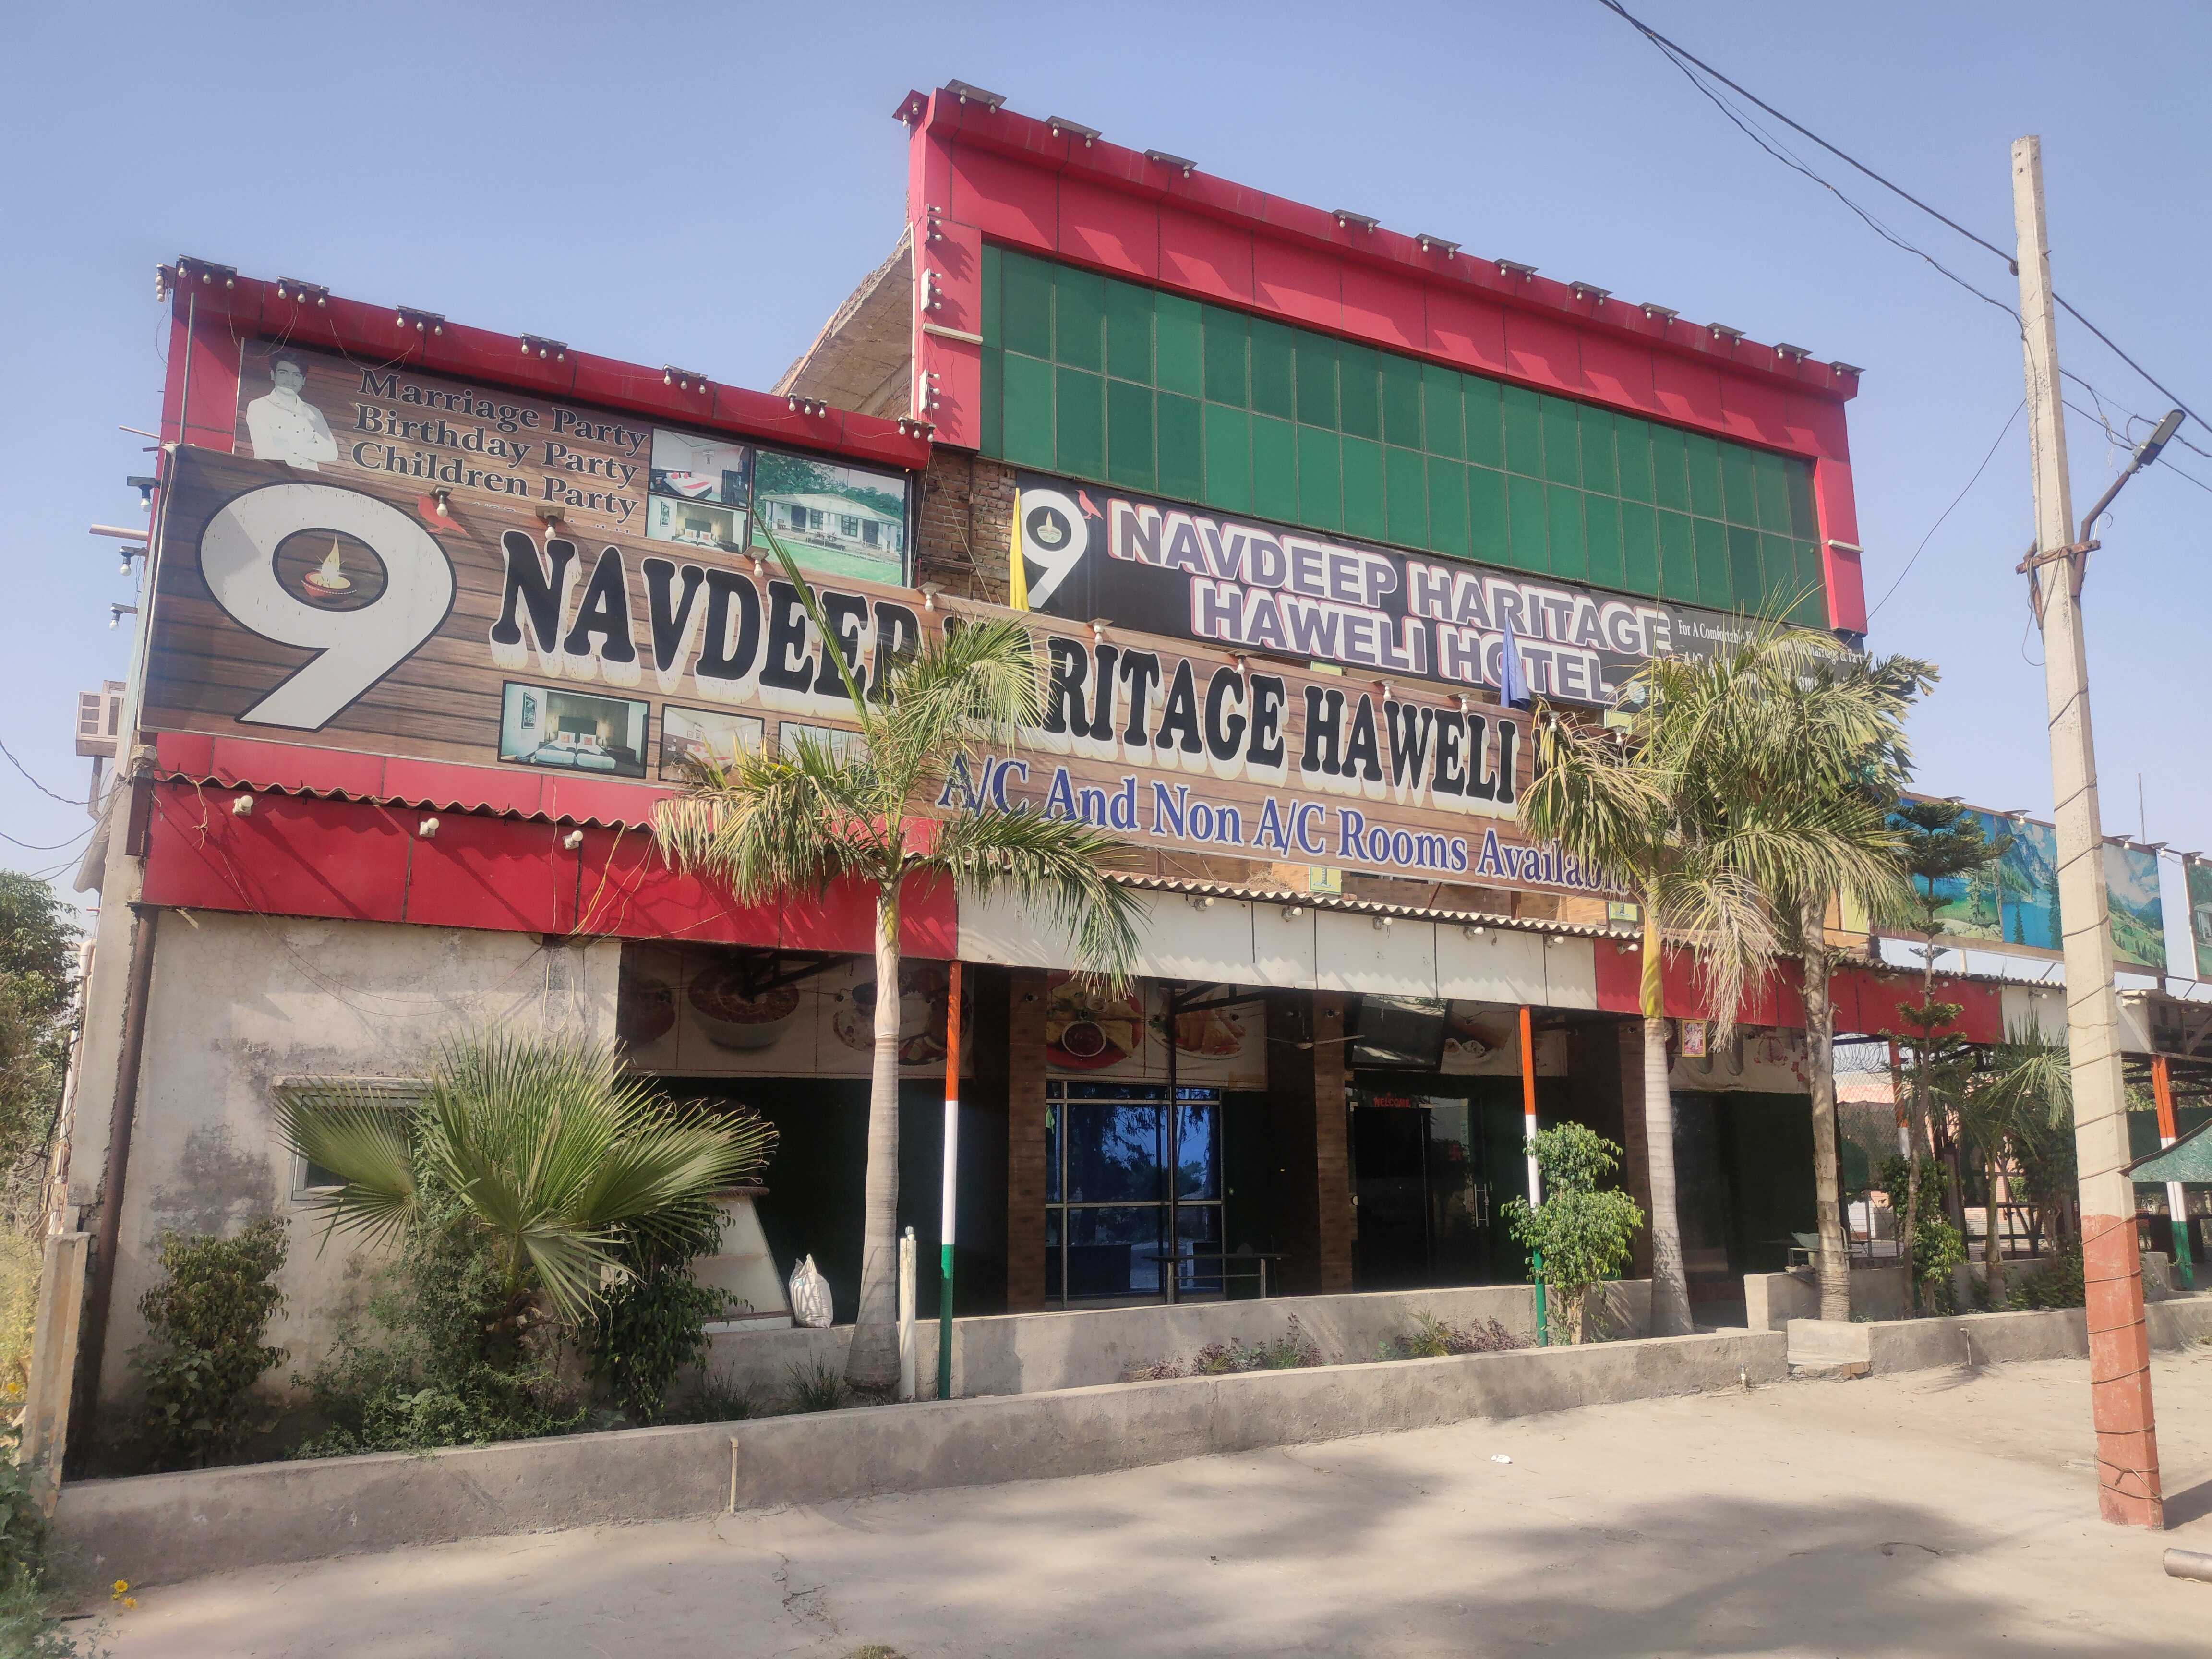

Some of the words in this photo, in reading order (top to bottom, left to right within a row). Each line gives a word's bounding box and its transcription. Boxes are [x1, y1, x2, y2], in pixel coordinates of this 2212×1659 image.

[353, 402, 532, 468] Birthday
[541, 440, 640, 489] Party
[358, 368, 541, 429] Marriage
[550, 406, 649, 457] Party
[351, 441, 530, 499] Children
[541, 475, 640, 525] Party
[1021, 489, 1088, 610] 9
[1107, 498, 1398, 609] NAVDEEP
[1406, 560, 1673, 660] HARITAGE
[197, 481, 457, 733] 9
[1190, 576, 1428, 674] HAWELI
[1678, 619, 1691, 636] For
[1692, 622, 1699, 637] A
[1847, 647, 1866, 664] Part
[489, 529, 926, 724] NAVDEEP
[939, 615, 1289, 788] RITAGE
[1299, 684, 1521, 821] HAWELI
[935, 750, 1030, 818] A/C
[1040, 764, 1140, 833] And
[1150, 779, 1245, 848] Non
[1251, 795, 1326, 858] A/C
[1336, 806, 1468, 874] Rooms
